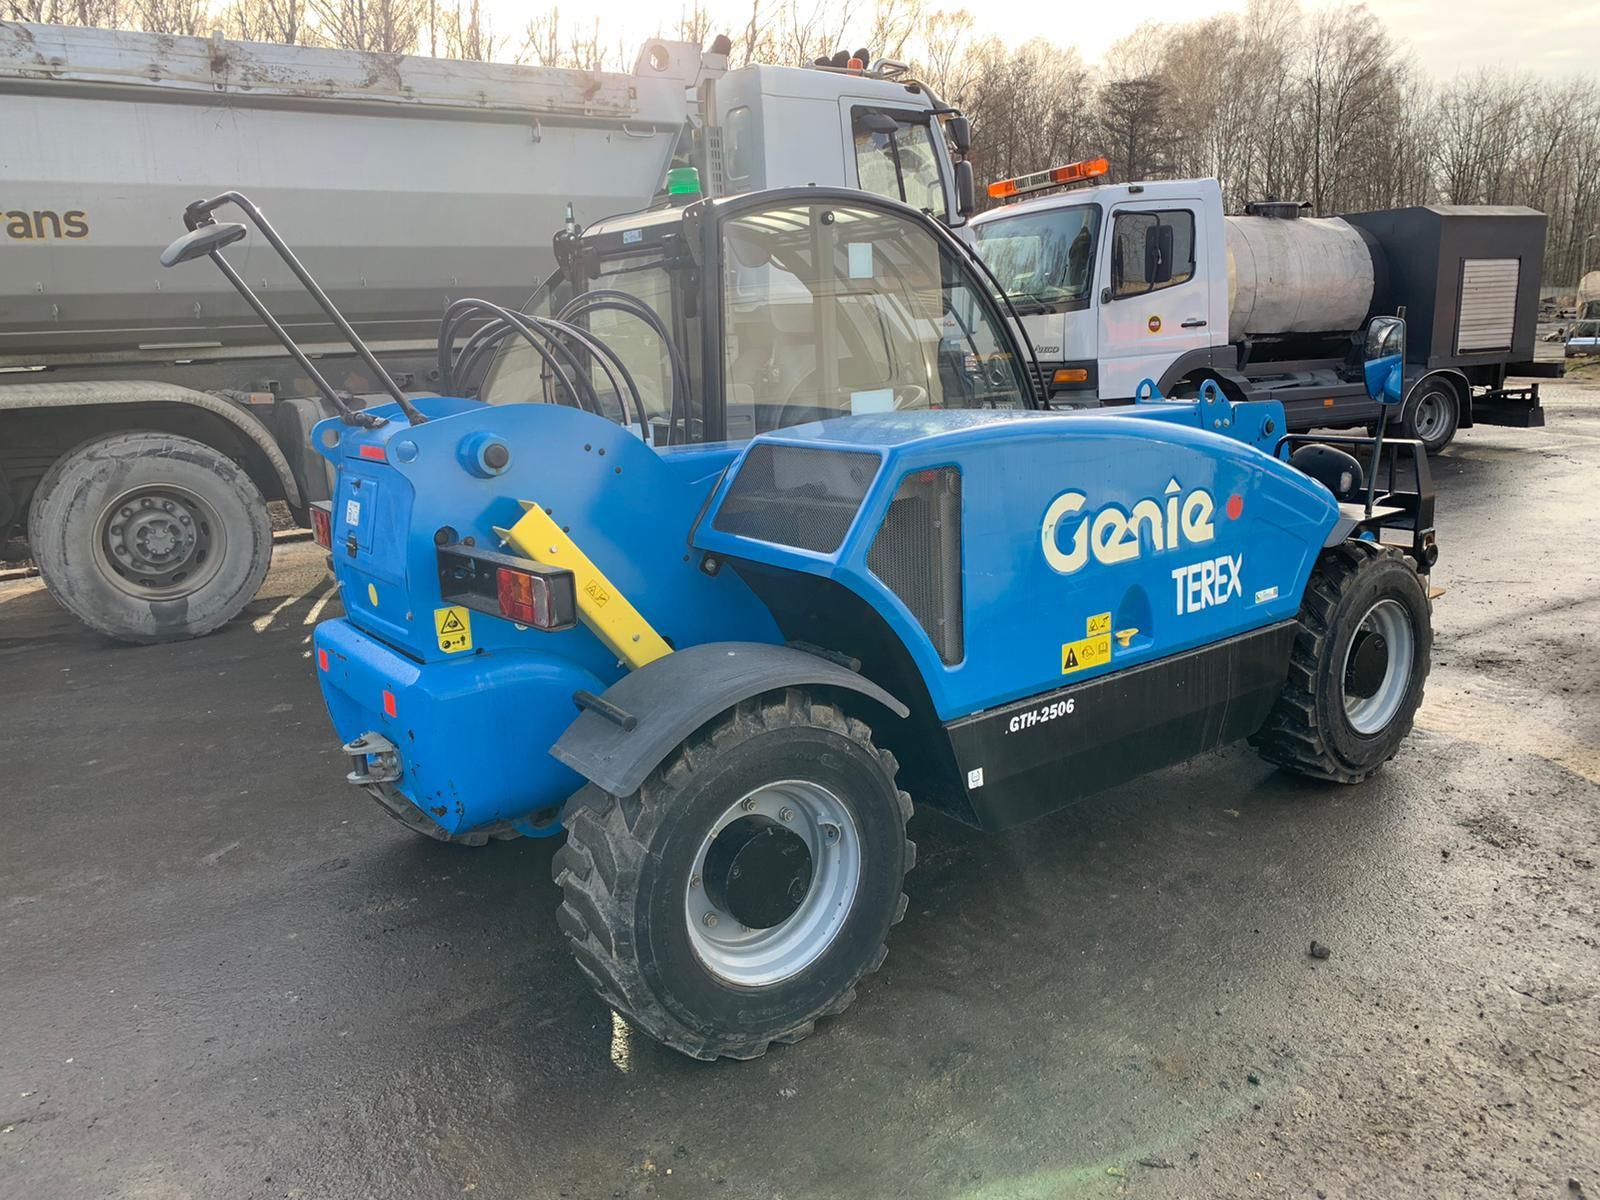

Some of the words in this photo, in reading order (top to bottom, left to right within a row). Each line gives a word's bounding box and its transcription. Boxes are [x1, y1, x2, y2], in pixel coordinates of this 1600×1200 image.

[0, 210, 89, 239] ans
[1042, 478, 1214, 573] Genie
[1171, 552, 1243, 616] TEREX
[1009, 698, 1075, 732] GTH-2506
